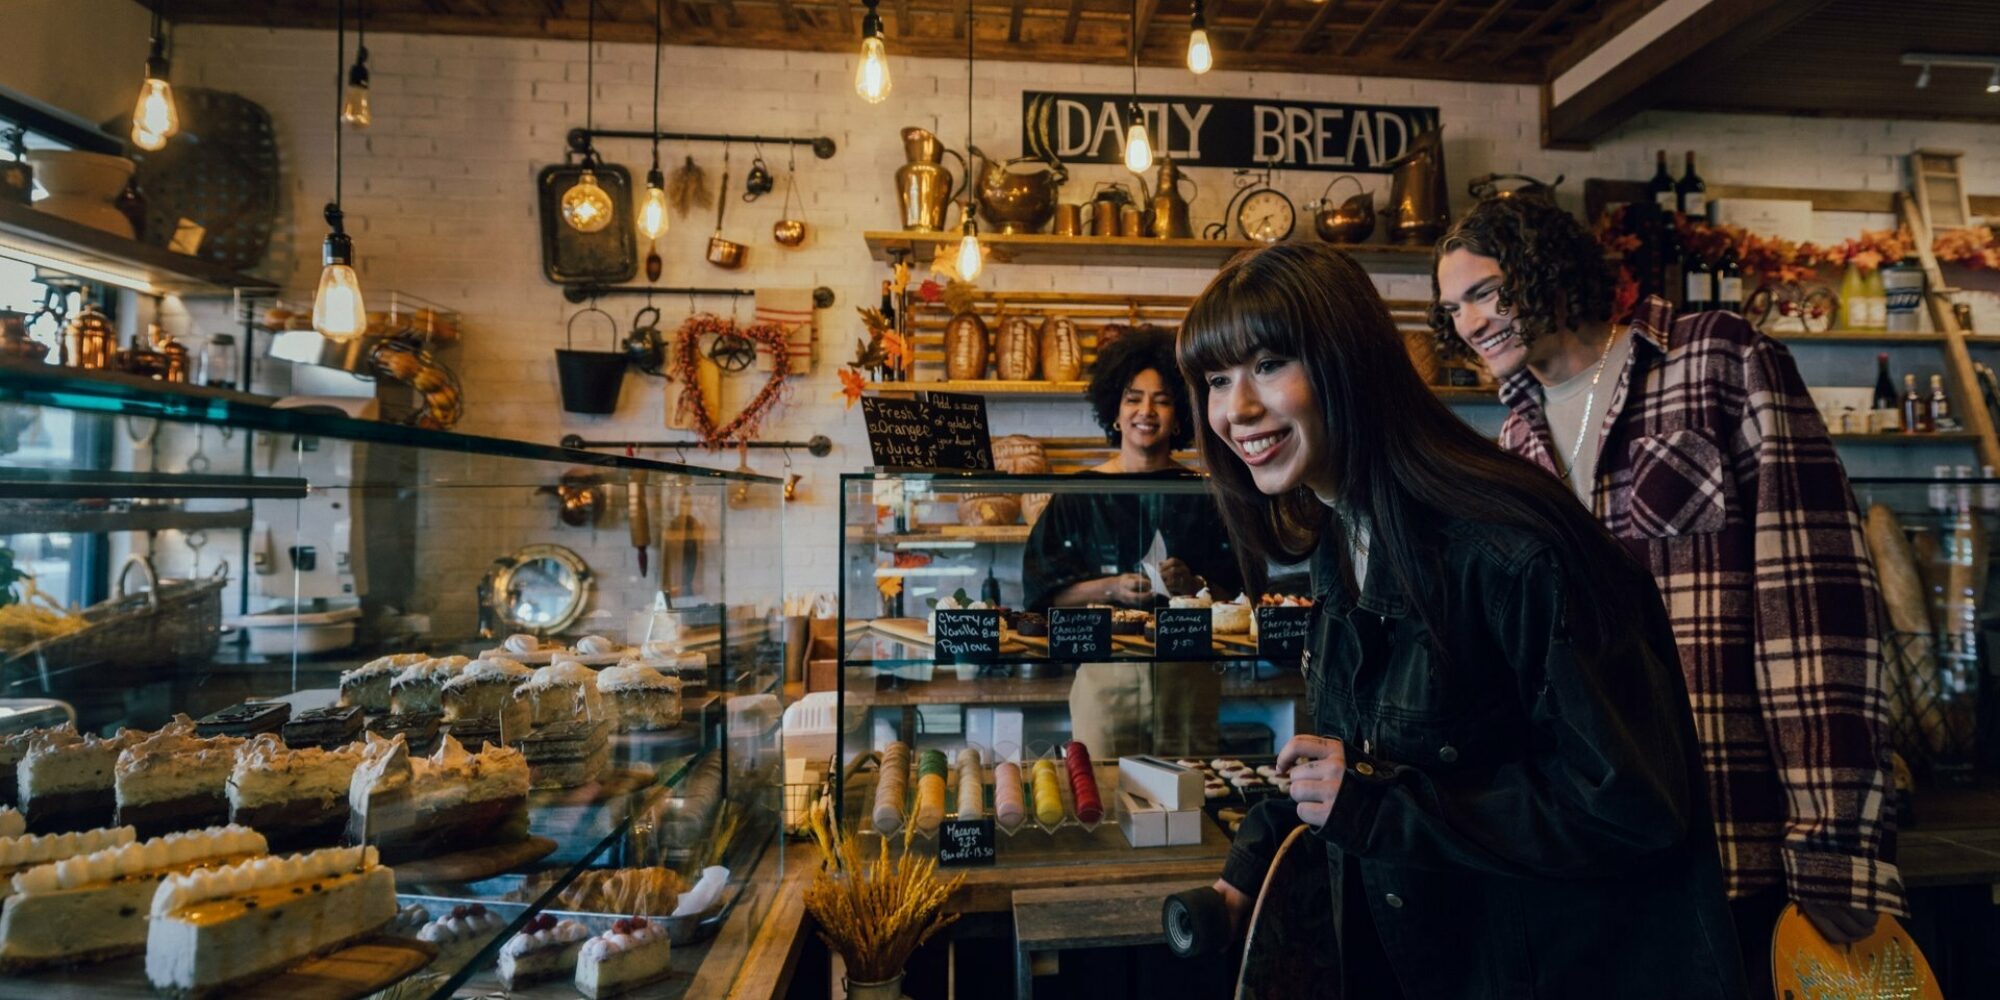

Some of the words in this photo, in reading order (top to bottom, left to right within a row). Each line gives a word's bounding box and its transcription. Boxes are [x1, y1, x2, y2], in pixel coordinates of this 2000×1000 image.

[1253, 105, 1408, 168] BREAD
[932, 393, 952, 410] Add
[878, 403, 917, 420] Fresh
[934, 414, 946, 427] of
[947, 416, 972, 434] gelato
[973, 416, 983, 430] to
[887, 438, 921, 455] Juice
[938, 612, 980, 627] Cherry
[982, 617, 996, 626] GF
[1052, 610, 1101, 625] Raspberry
[1159, 611, 1201, 623] Caramel
[938, 623, 979, 637] Vanilla
[937, 639, 992, 654] Pavlova
[1072, 642, 1096, 654] 8.50
[946, 823, 982, 841] Macaron
[941, 849, 955, 861] Box
